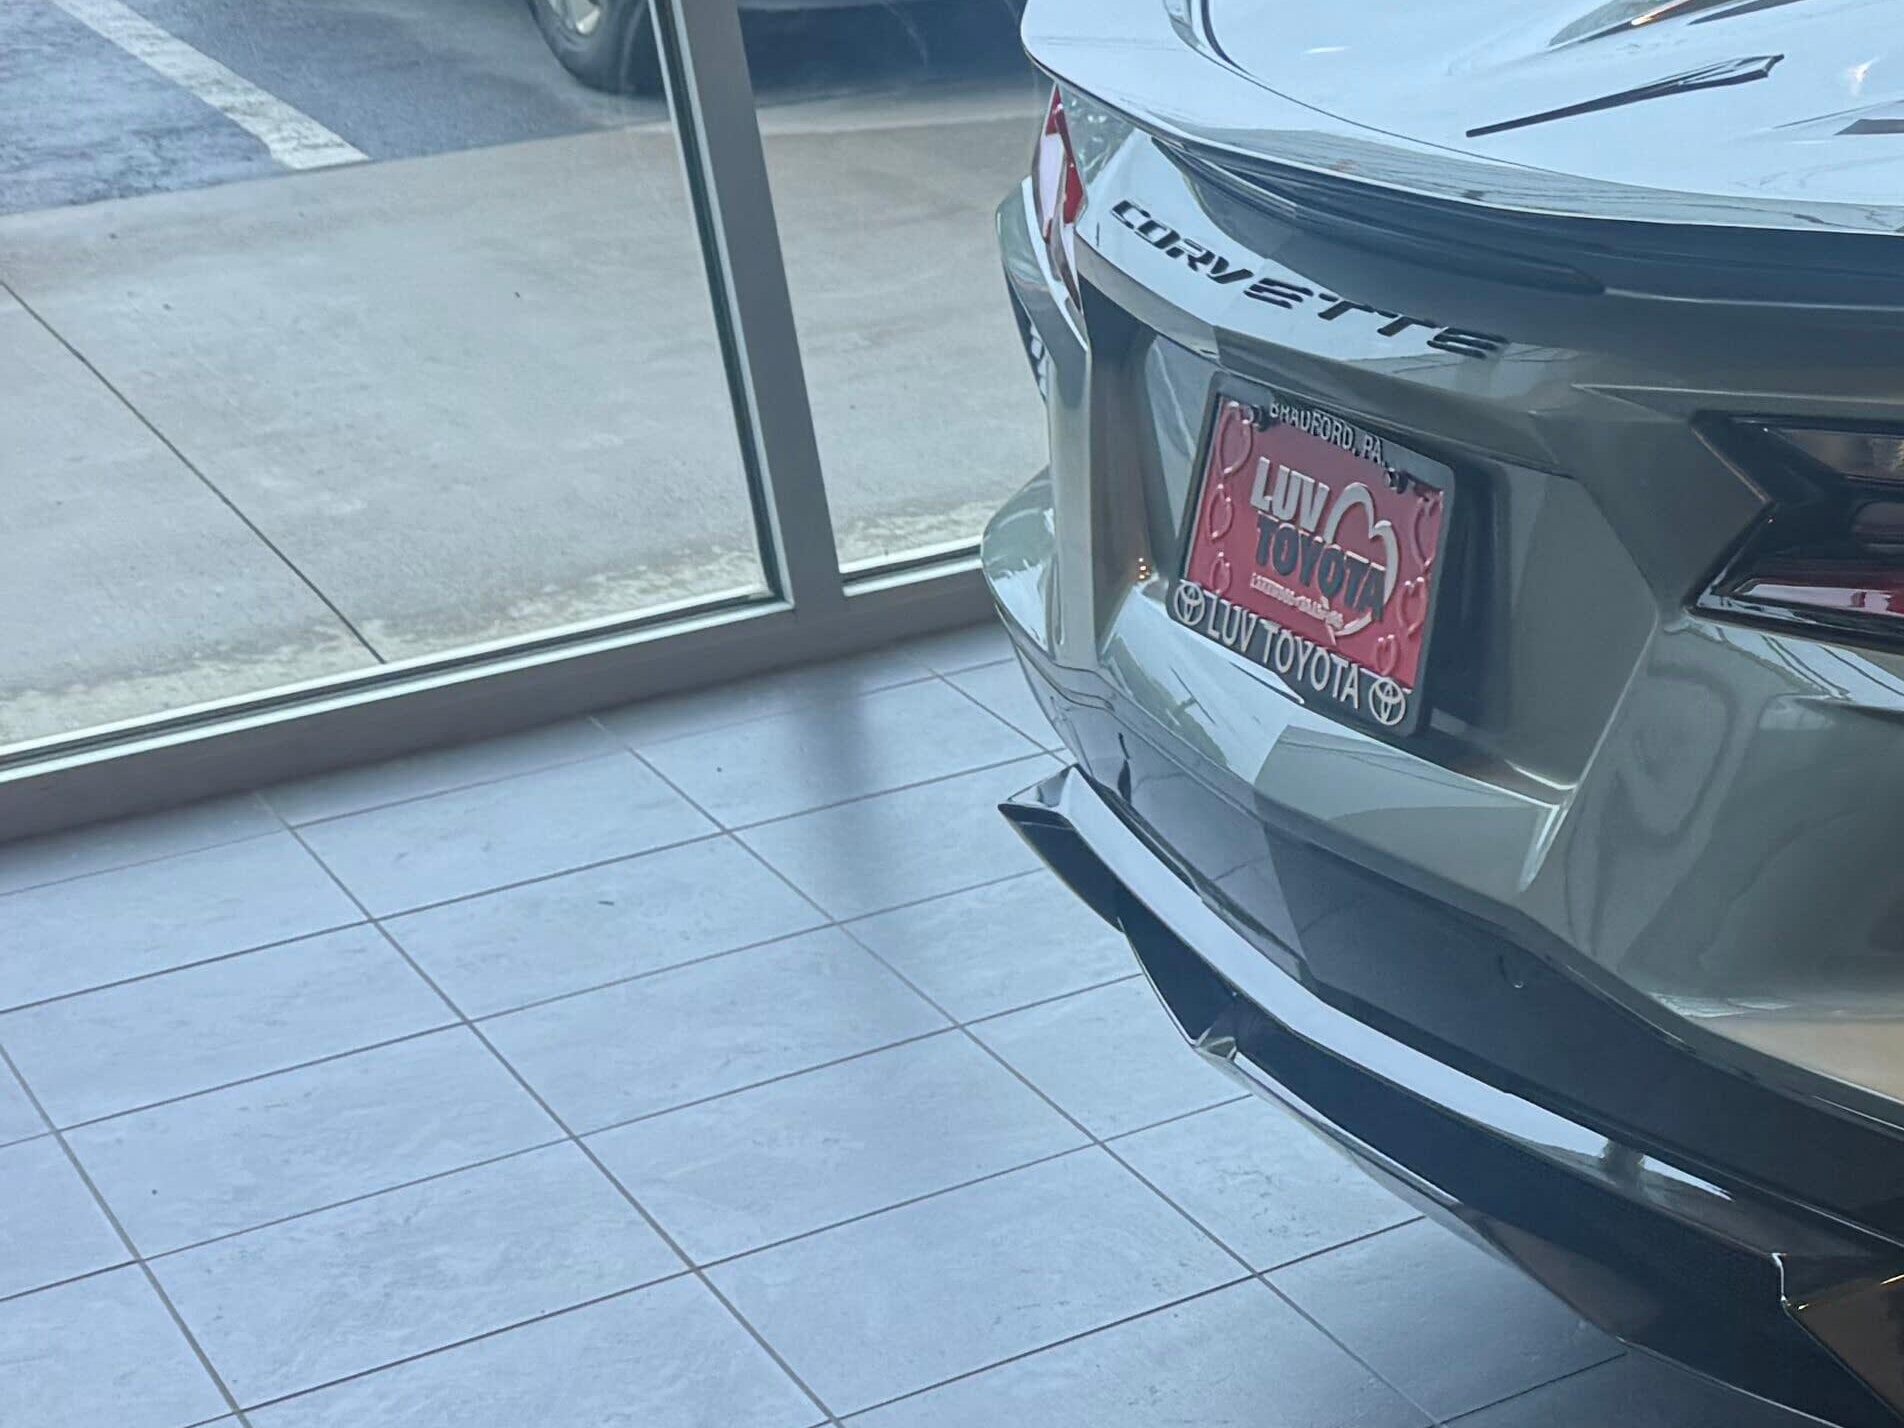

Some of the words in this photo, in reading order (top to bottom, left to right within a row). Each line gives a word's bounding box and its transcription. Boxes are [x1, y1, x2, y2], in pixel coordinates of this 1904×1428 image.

[1111, 199, 1508, 359] CORVETTE
[1250, 456, 1330, 533] LUV
[1255, 510, 1387, 623] TOYOTA
[1203, 589, 1258, 653] LUV
[1259, 618, 1360, 710] TOYOTA
